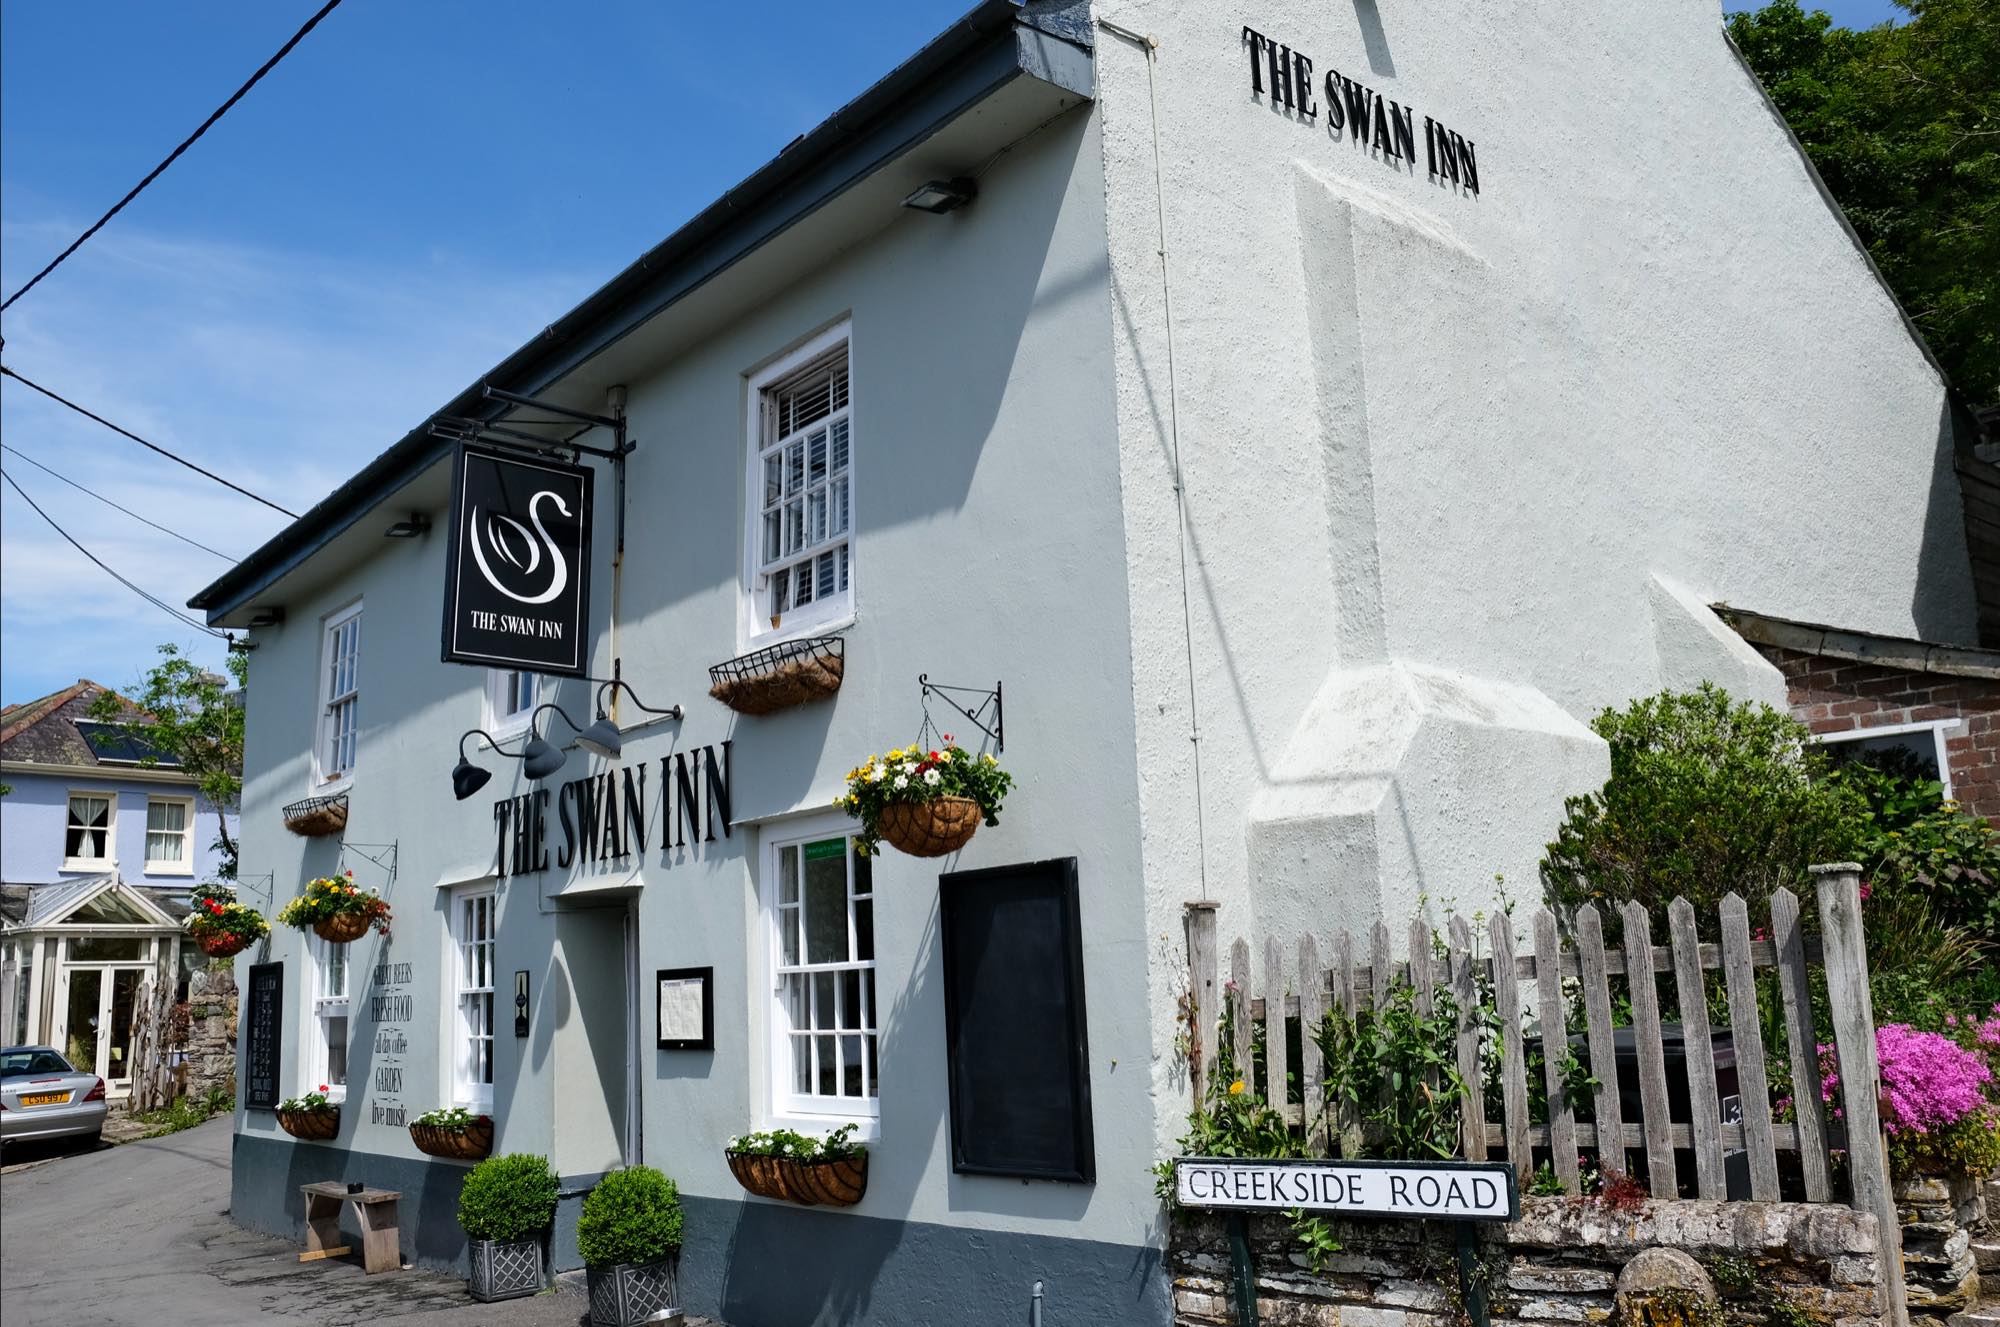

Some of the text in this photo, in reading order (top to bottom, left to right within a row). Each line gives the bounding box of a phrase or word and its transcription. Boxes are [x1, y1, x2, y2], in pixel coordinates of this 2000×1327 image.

[1243, 25, 1480, 195] THE SWAN INN
[470, 610, 563, 640] THE SWAN INN
[494, 740, 733, 880] THE SWAN INN
[374, 962, 412, 985] GREAT BEERS
[371, 995, 413, 1022] FRESH FOOD
[382, 1032, 391, 1058] day
[391, 1032, 408, 1054] coffee
[375, 1066, 402, 1093] GARDEN
[371, 1099, 385, 1125] live
[1189, 1168, 1499, 1210] CREEKSIDE ROAD
